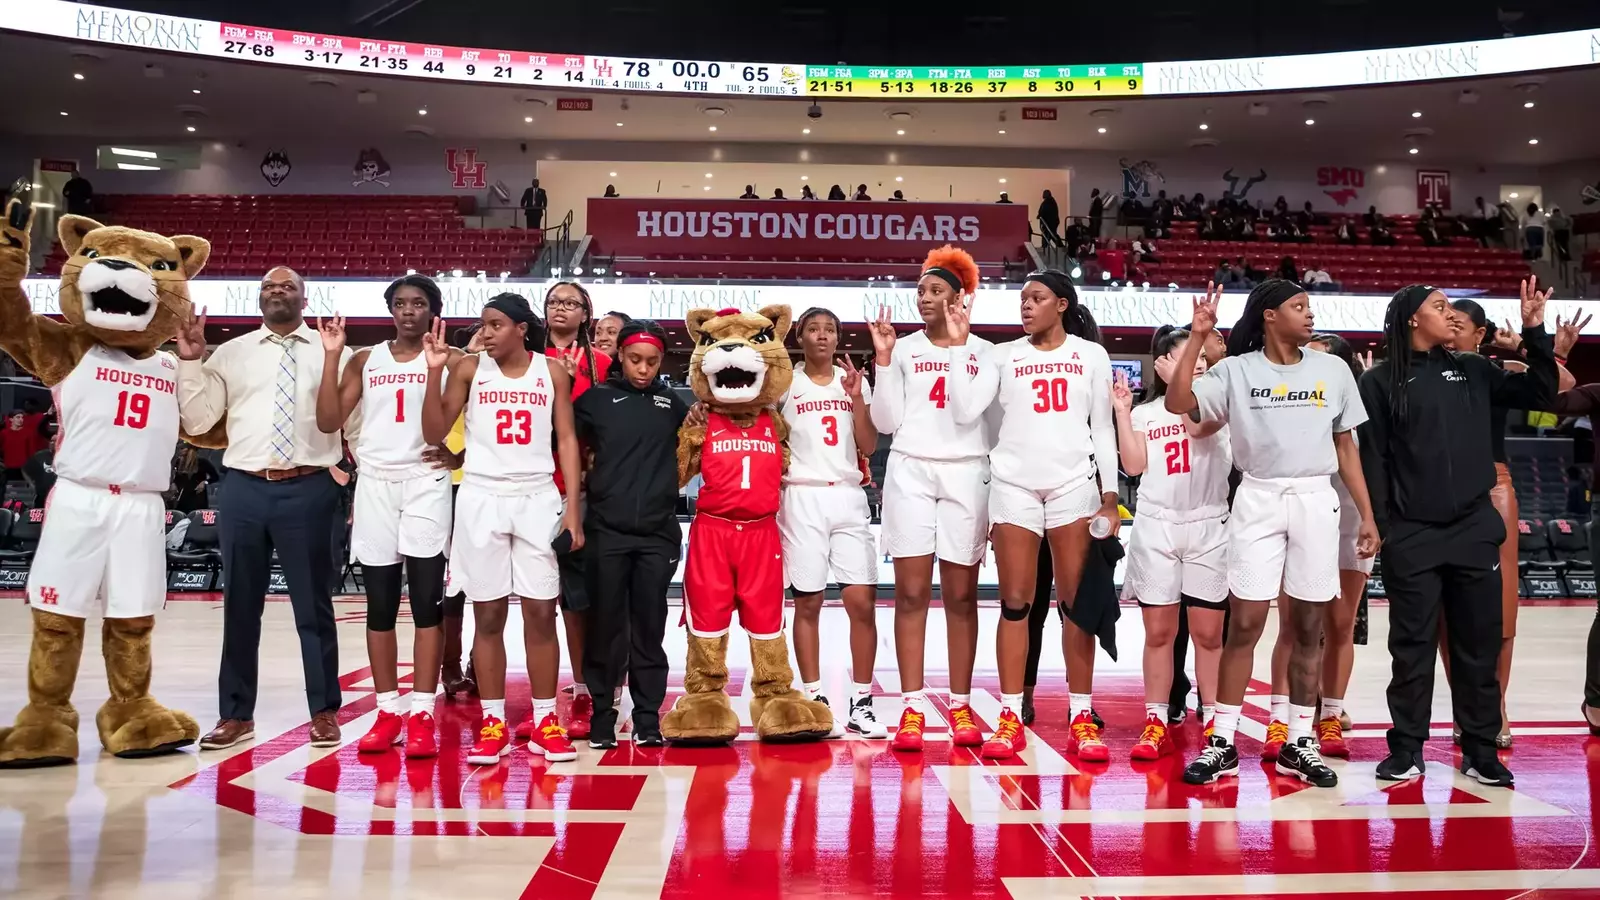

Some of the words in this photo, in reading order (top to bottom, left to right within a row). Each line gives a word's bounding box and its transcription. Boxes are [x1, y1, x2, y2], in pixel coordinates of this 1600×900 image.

[77, 8, 201, 39] MEMORIAL
[76, 20, 199, 51] HERMANN
[224, 40, 275, 57] 27-68
[304, 49, 343, 64] 3-17
[360, 55, 408, 70] 21-35
[423, 61, 444, 73] 44
[466, 64, 475, 76] 9
[494, 67, 512, 78] 21
[533, 69, 543, 80] 2
[565, 71, 583, 82] 14
[424, 48, 443, 58] REB
[461, 51, 480, 60] AST
[498, 53, 511, 63] TO
[530, 55, 547, 66] BLK
[623, 62, 650, 77] 78
[672, 61, 720, 78] 00.0
[743, 66, 769, 82] 65
[987, 69, 1006, 78] REB
[1023, 69, 1041, 78] AST
[1057, 68, 1071, 77] TO
[1087, 67, 1106, 77] BLK
[1122, 66, 1141, 76] STL
[612, 80, 619, 88] 4
[684, 81, 708, 91] 4TH
[809, 81, 852, 92] 21-51
[880, 82, 914, 92] 5-13
[929, 82, 973, 92] 18-26
[988, 82, 1007, 92] 37
[1028, 82, 1037, 92] 8
[1055, 81, 1074, 91] 30
[1094, 80, 1101, 90] 1
[1127, 79, 1137, 89] 9
[444, 148, 487, 189] UH
[1317, 167, 1364, 188] SMU
[637, 211, 808, 239] HOUSTON
[815, 213, 980, 241] COUGARS
[650, 289, 759, 305] MEMORIAL
[1015, 363, 1083, 378] HOUSTON
[96, 367, 175, 394] HOUSTON
[369, 373, 426, 388] HOUSTO
[479, 391, 547, 407] HOUSTON
[929, 376, 949, 409] 4
[1032, 377, 1068, 413] 30
[1250, 387, 1271, 398] GO
[1287, 390, 1326, 401] GOAL
[113, 390, 151, 429] 19
[395, 388, 405, 422] 1
[796, 400, 854, 415] HOUSTON
[495, 409, 532, 445] 23
[821, 415, 838, 446] 3
[712, 440, 776, 454] HOUSTON
[1164, 438, 1191, 475] 21
[740, 455, 751, 489] 1
[184, 573, 206, 583] JOINT
